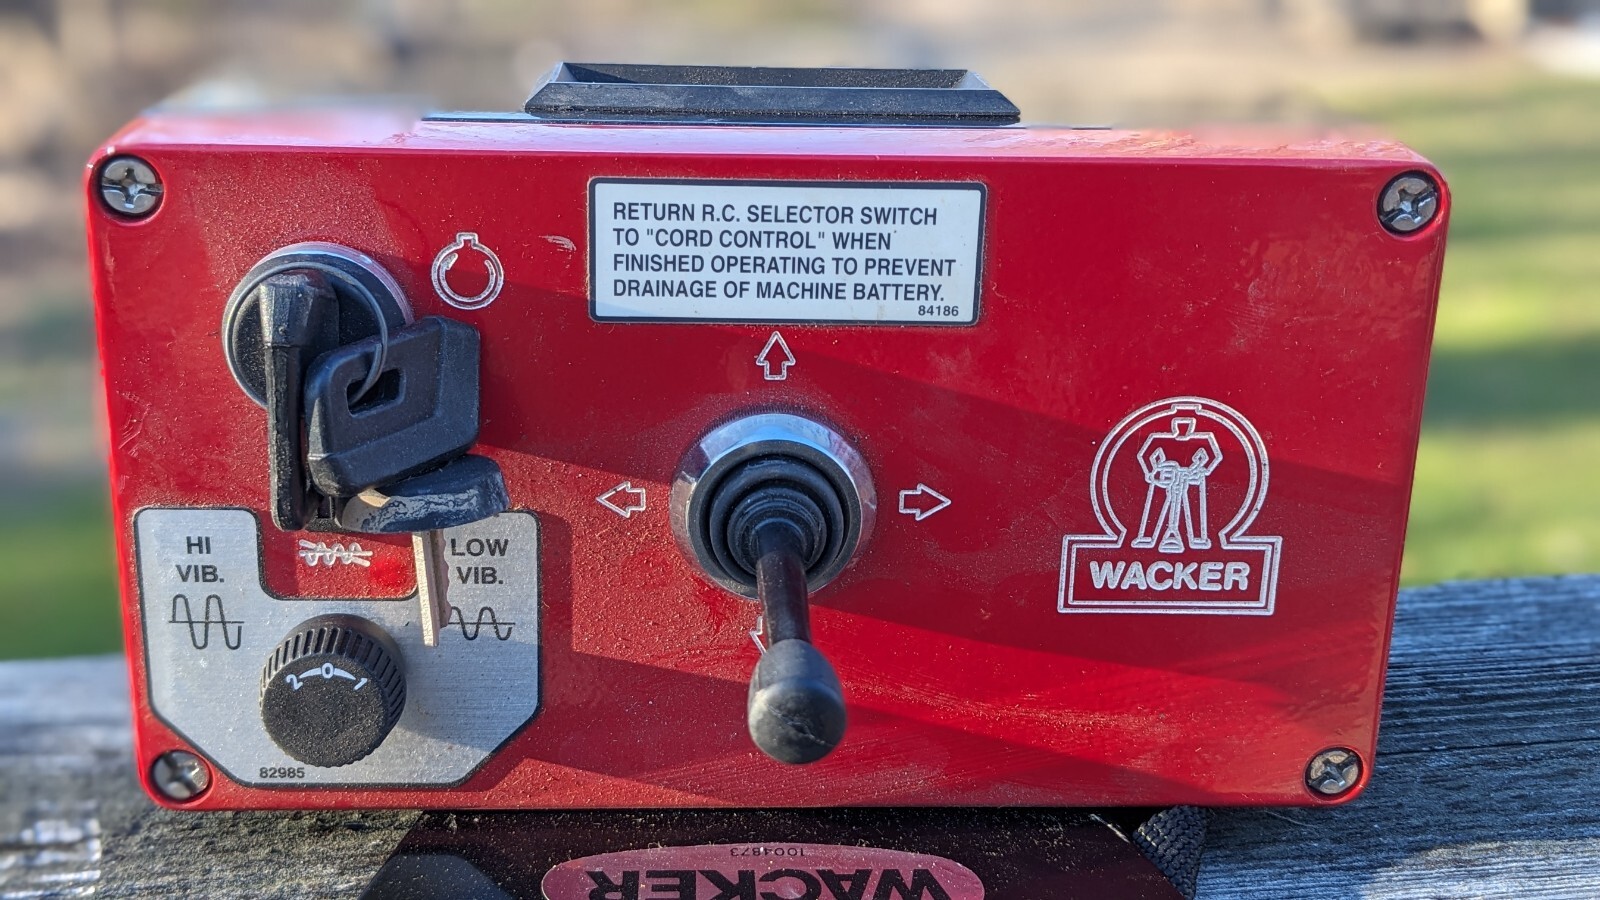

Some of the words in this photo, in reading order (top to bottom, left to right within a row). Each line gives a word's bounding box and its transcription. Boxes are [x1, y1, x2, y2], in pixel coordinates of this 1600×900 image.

[613, 202, 695, 222] RETURN
[702, 204, 740, 222] R.C.
[747, 204, 854, 224] SELECTOR
[860, 206, 937, 225] SWITCH
[613, 228, 640, 246] TO
[646, 228, 713, 247] "CORD
[719, 230, 825, 249] CONTROL"
[832, 232, 891, 250] WHEN
[613, 253, 704, 272] FINISHED
[711, 255, 825, 275] OPERATING
[832, 257, 858, 275] TO
[864, 258, 956, 276] PREVENT
[613, 279, 717, 298] DRAINAGE
[723, 281, 750, 298] OF
[756, 281, 846, 299] MACHINE
[853, 283, 944, 301] BATTERY.
[917, 305, 959, 316] 84186
[186, 536, 211, 555] HI
[450, 538, 509, 557] LOW
[176, 565, 225, 583] VIB.
[456, 567, 504, 585] VIB.
[1089, 561, 1250, 591] WACKER
[286, 674, 303, 690] 2
[321, 662, 335, 679] 0
[353, 677, 368, 690] 1
[259, 767, 305, 778] 82985
[730, 847, 804, 857] 1004873
[586, 868, 950, 900] WACKER
